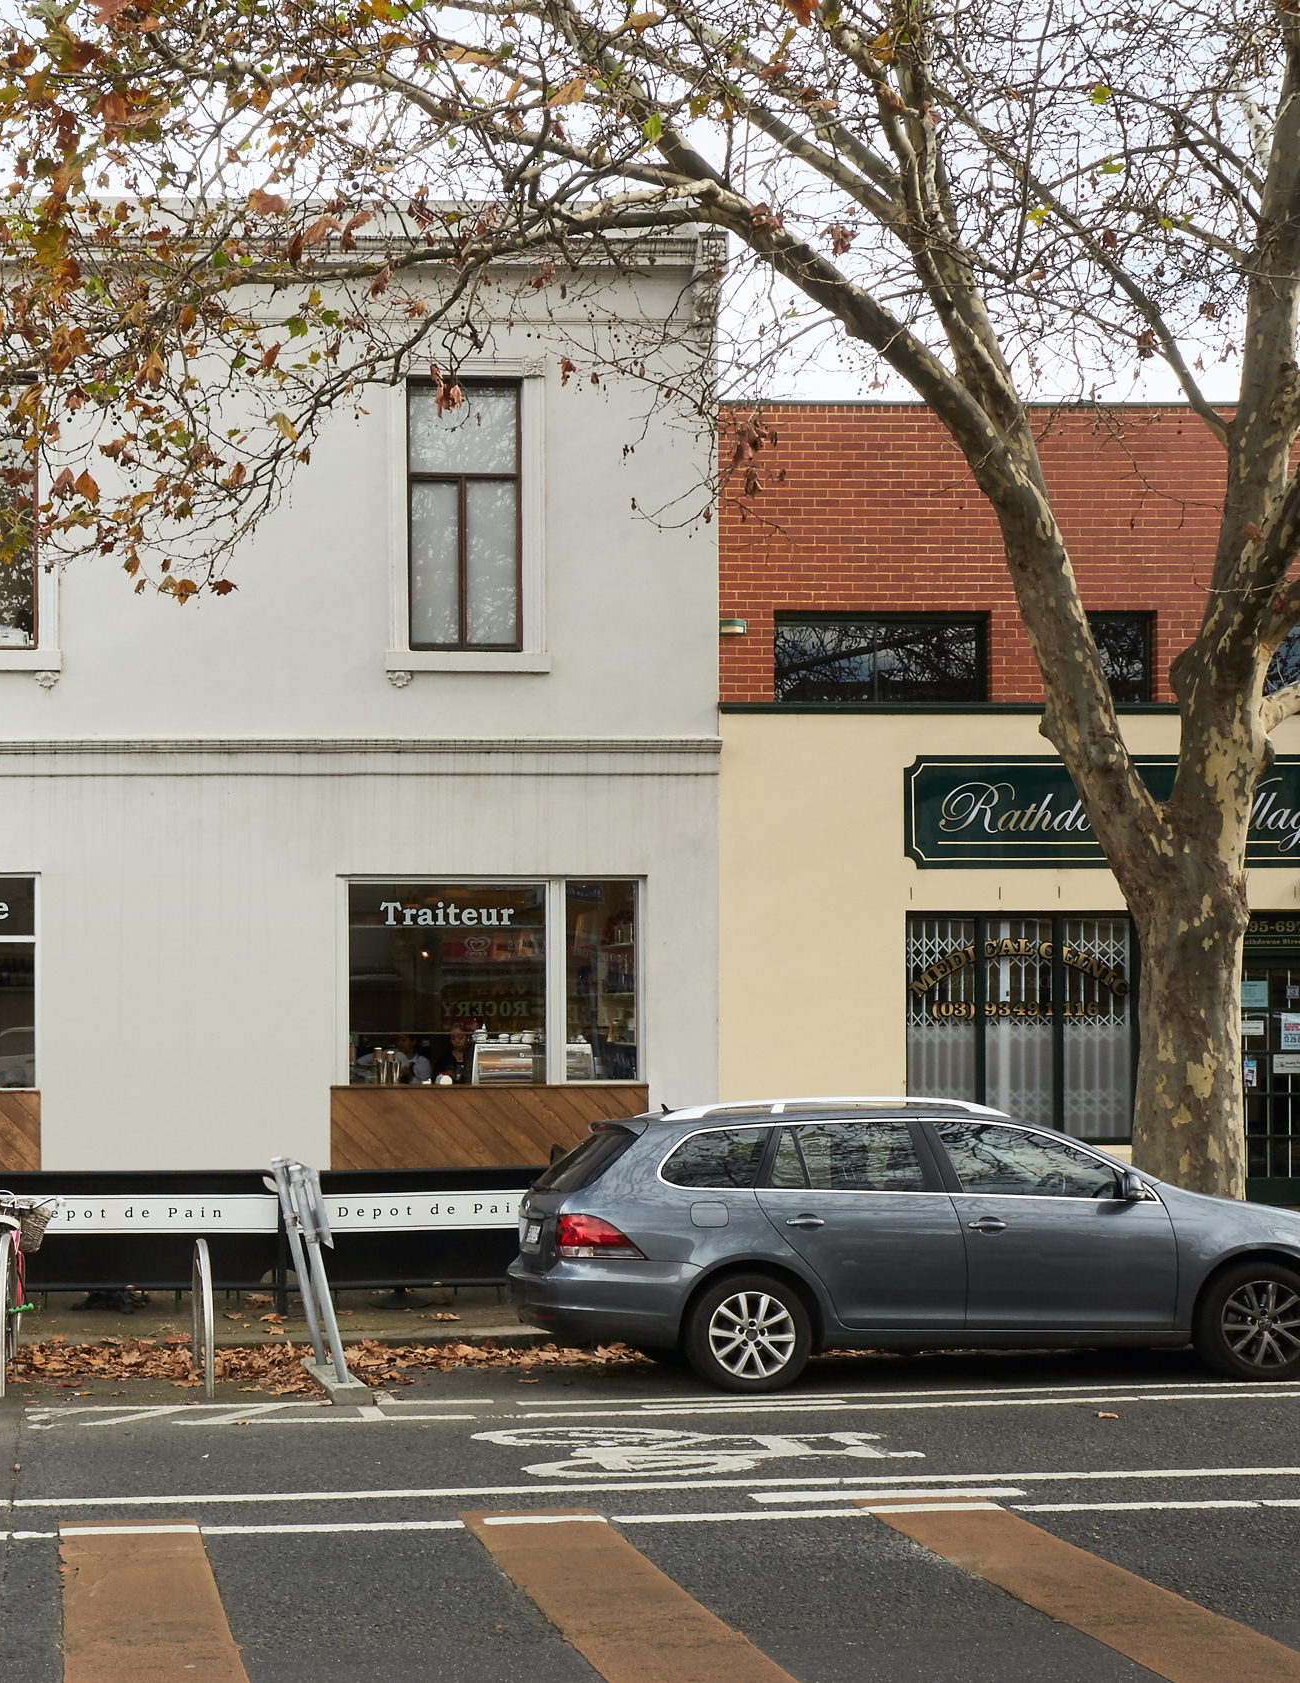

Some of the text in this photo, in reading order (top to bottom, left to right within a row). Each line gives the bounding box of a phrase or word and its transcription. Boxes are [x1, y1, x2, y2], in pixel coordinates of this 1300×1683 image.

[938, 777, 1300, 853] Rathdo llag
[379, 901, 515, 926] Traiteur
[1249, 920, 1300, 933] 95-69
[908, 938, 1131, 997] MEDICAL CLINIC
[931, 1001, 976, 1019] (03)
[984, 1002, 1040, 1017] 9349
[50, 1206, 222, 1222] epot de Pain
[337, 1202, 521, 1220] Depot de Pai
